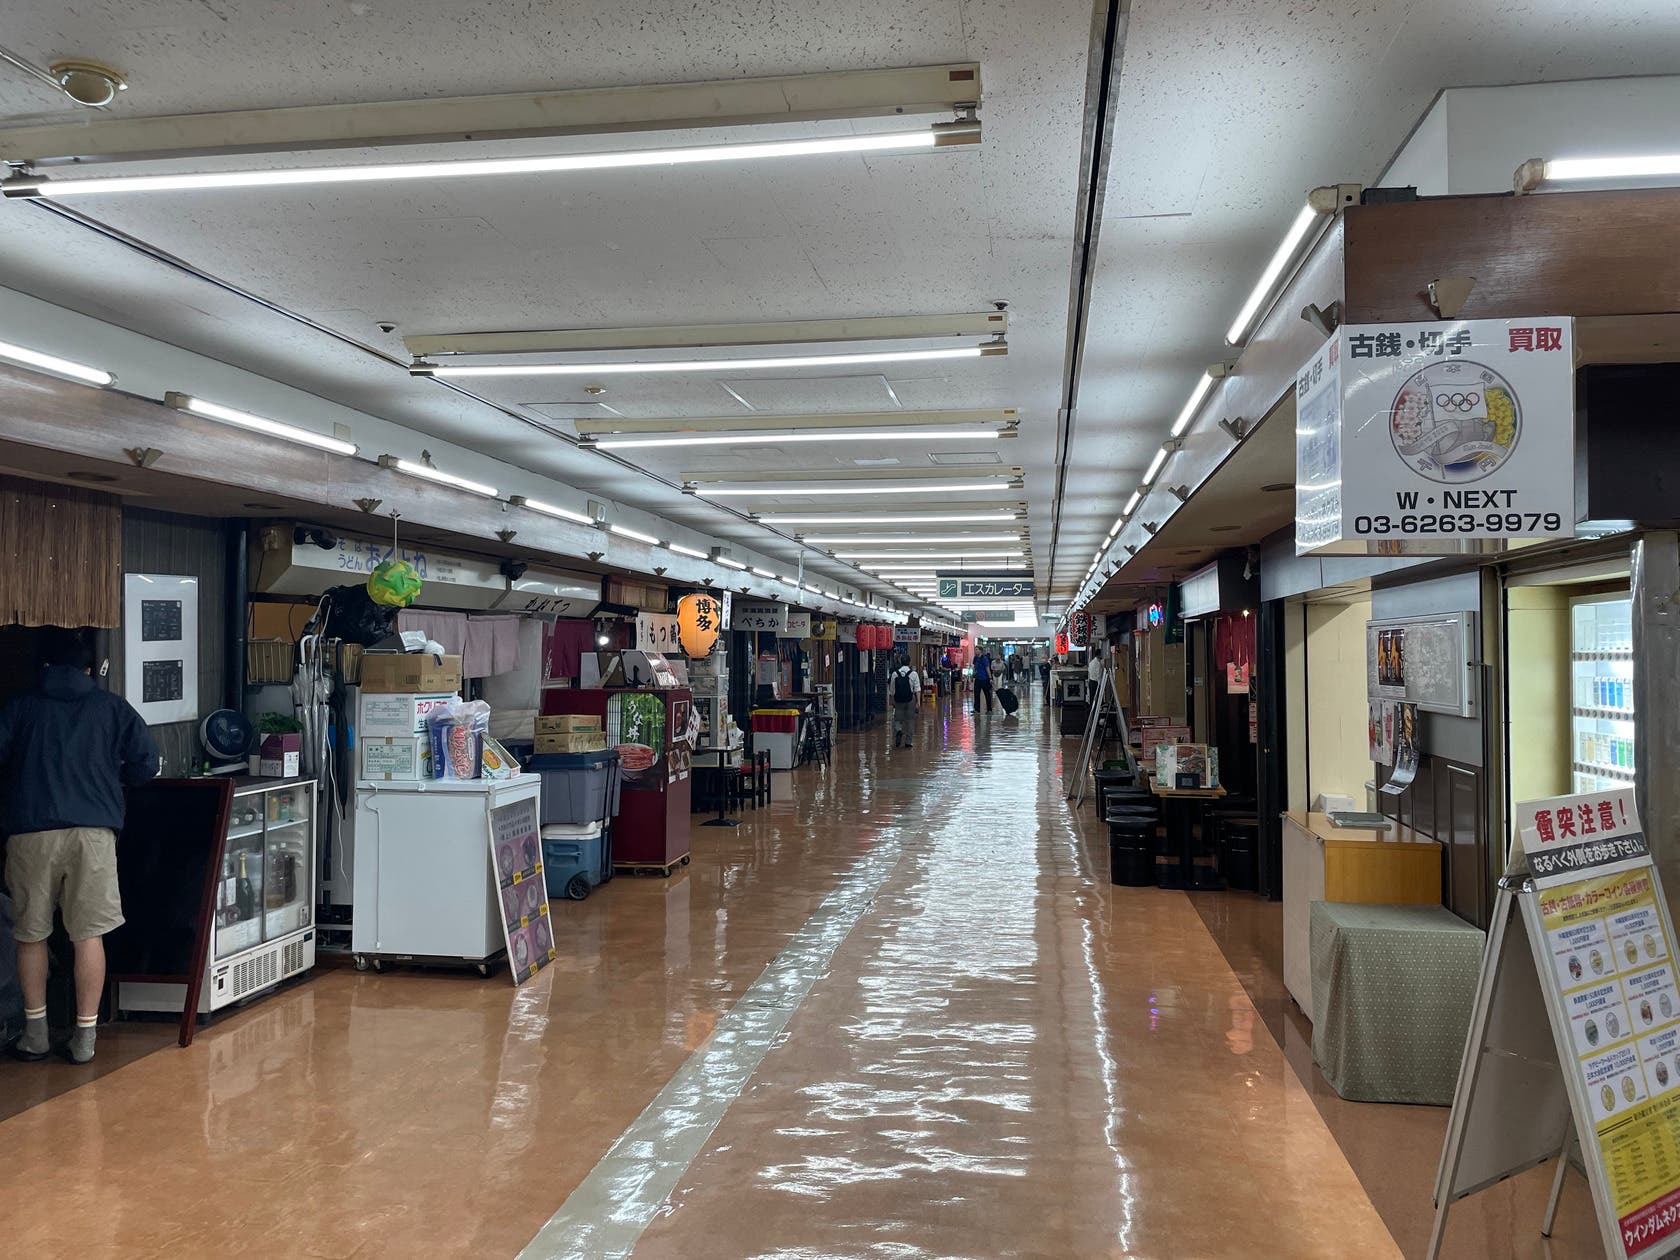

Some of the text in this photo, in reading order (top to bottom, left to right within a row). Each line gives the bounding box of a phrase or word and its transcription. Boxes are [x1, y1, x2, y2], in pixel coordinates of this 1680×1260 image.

[1349, 329, 1472, 359] 古銭・切手
[1508, 327, 1562, 353] 買取
[1354, 512, 1562, 535] 03-6263-9979
[337, 553, 363, 571] うどん
[965, 582, 1032, 596] エスカレーター
[695, 598, 713, 632] 博多
